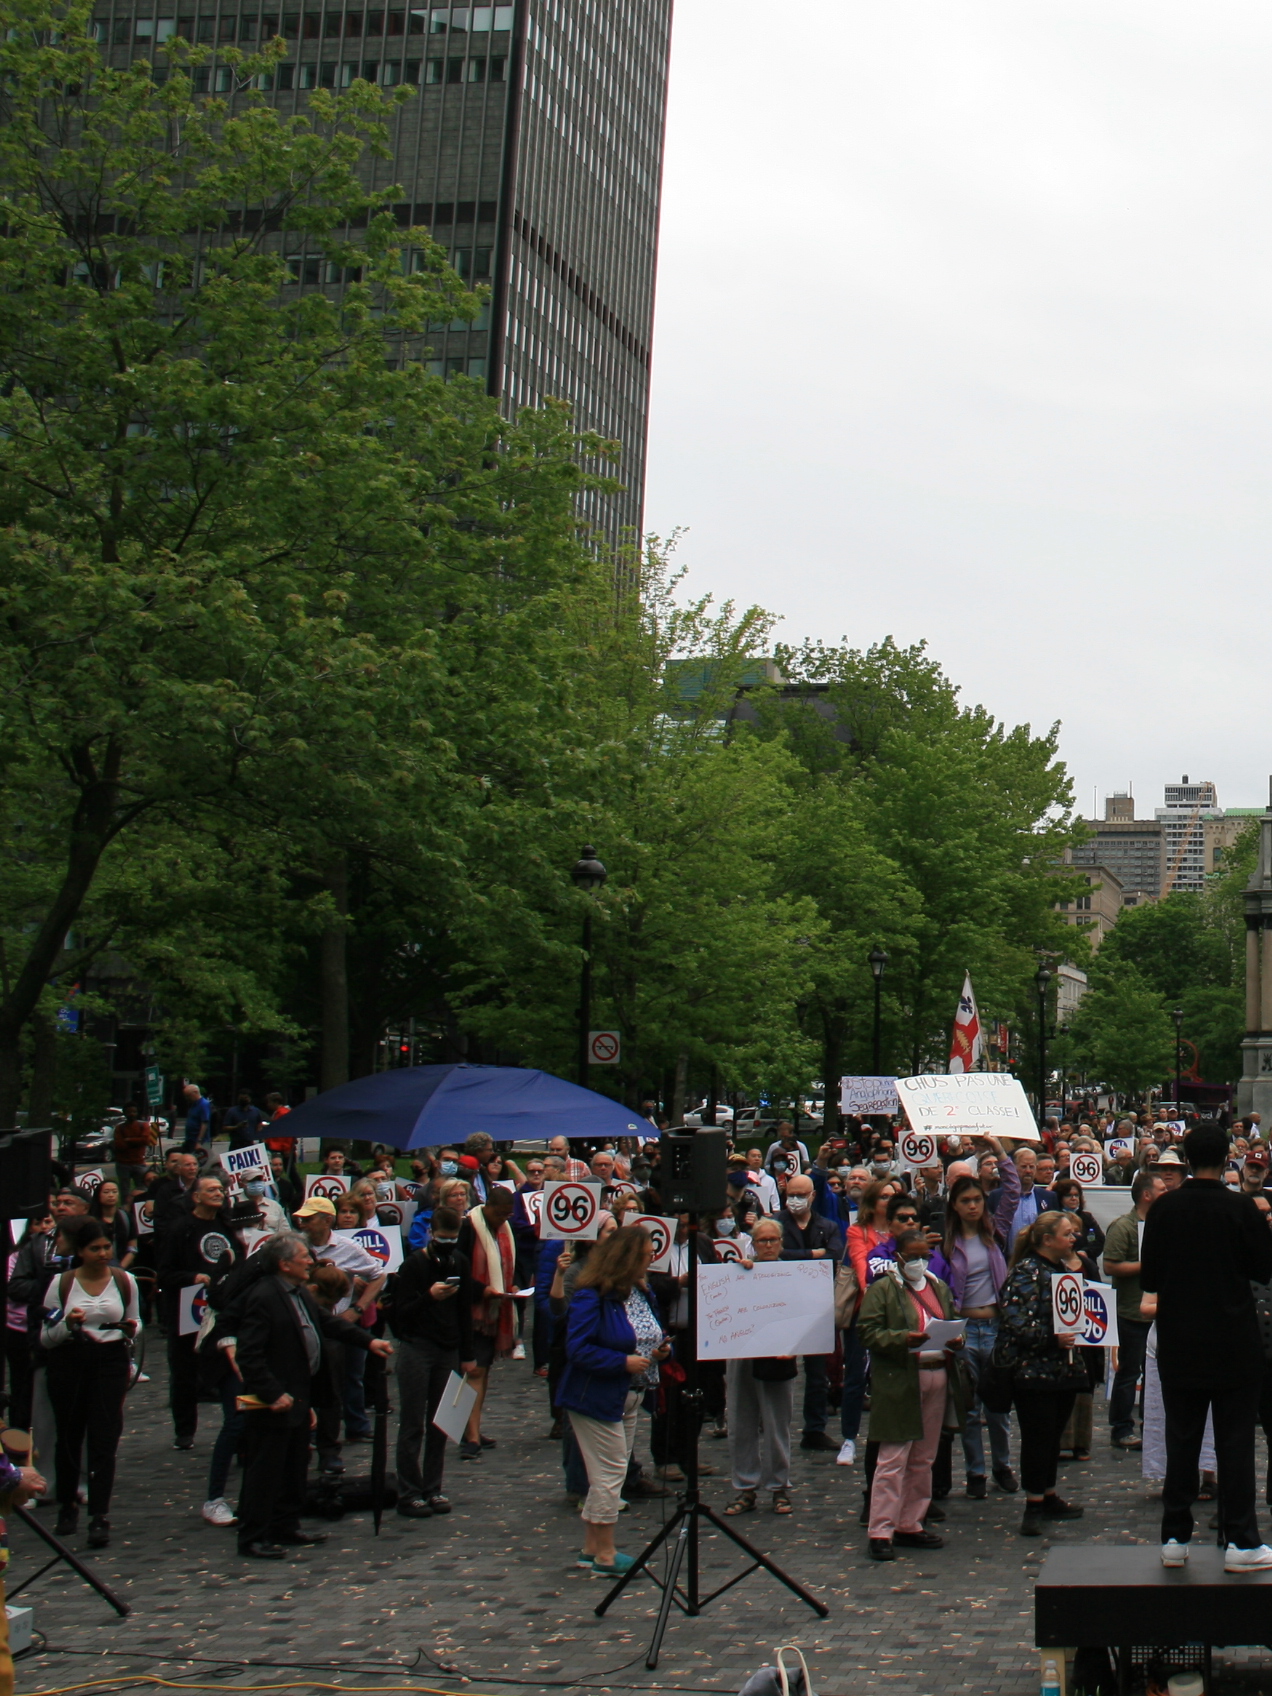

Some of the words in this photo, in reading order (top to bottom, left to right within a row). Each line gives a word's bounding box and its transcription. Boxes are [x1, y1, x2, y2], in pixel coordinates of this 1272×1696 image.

[903, 1076, 949, 1091] CHUS
[955, 1075, 985, 1087] PAS
[986, 1075, 1012, 1086] UNE
[919, 1106, 938, 1117] DE
[907, 1138, 930, 1157] 96
[228, 1148, 261, 1172] PAIX!
[1077, 1160, 1096, 1176] 96
[554, 1196, 589, 1222] 96
[354, 1234, 384, 1248] BILL
[1059, 1287, 1078, 1314] 96
[1083, 1296, 1103, 1313] BILL
[1085, 1315, 1103, 1339] 96
